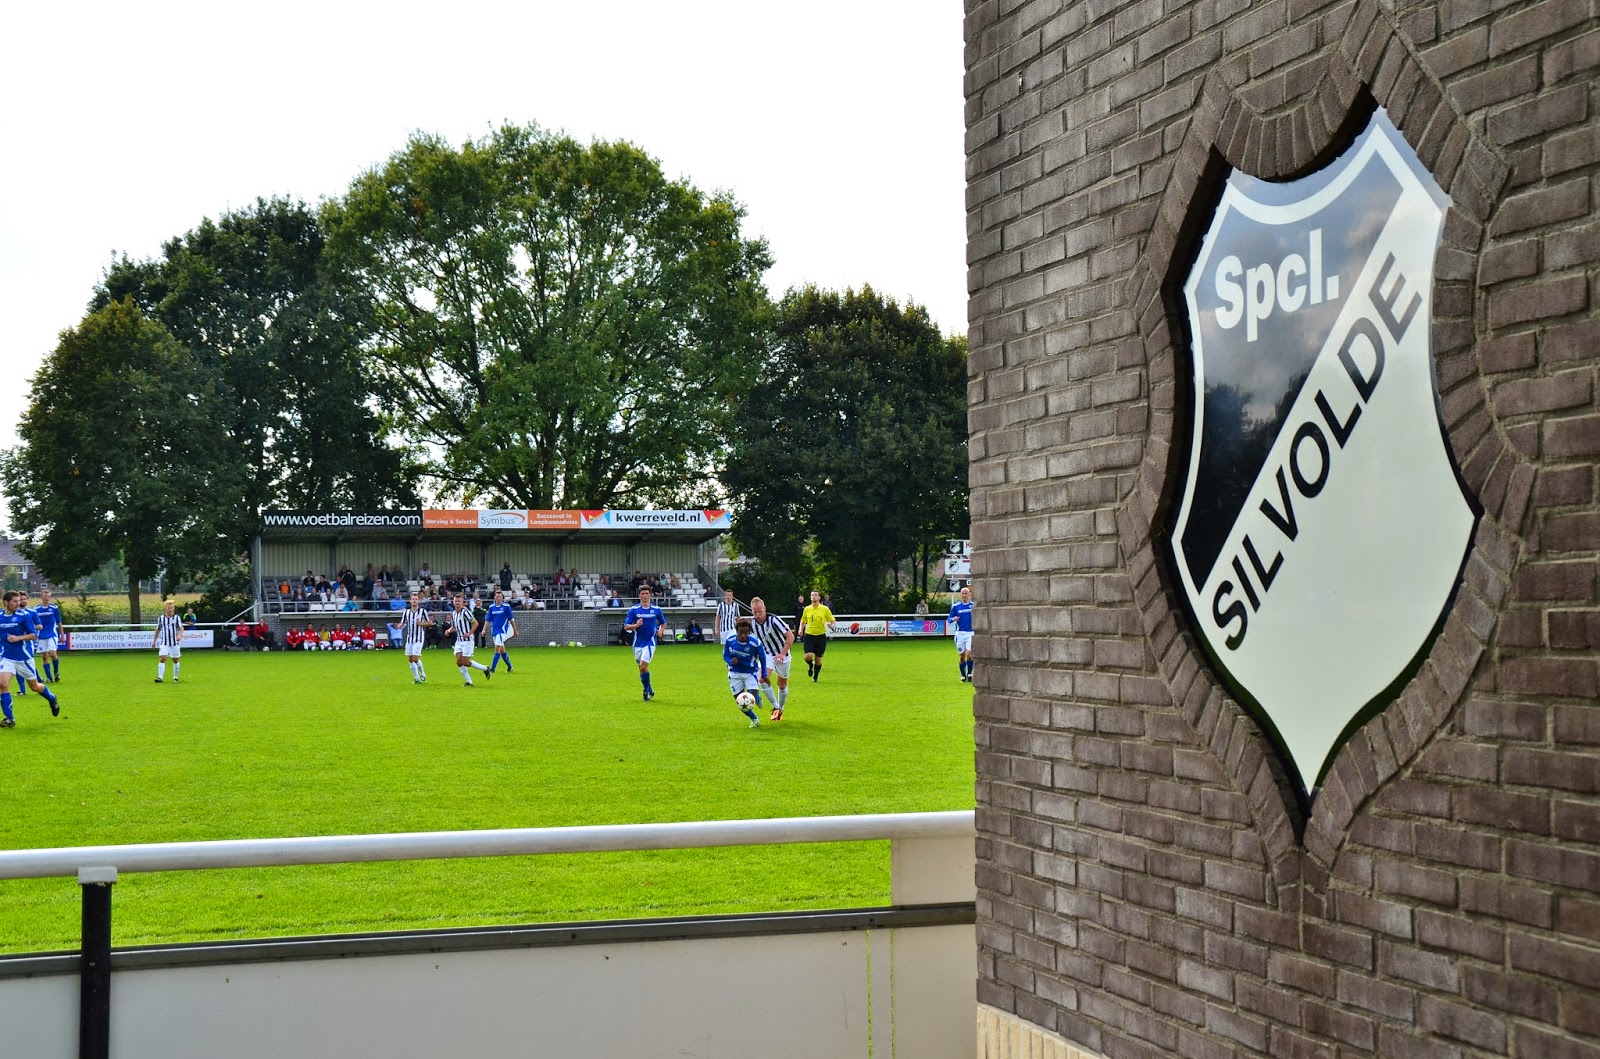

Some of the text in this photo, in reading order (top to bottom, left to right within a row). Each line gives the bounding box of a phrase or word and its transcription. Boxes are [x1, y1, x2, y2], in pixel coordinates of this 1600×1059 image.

[1214, 227, 1340, 342] Spcl.
[1212, 252, 1423, 651] SILVOLDE
[263, 512, 421, 526] www.voetbalreizen.com
[425, 518, 477, 527] Werving & Selectie
[481, 516, 516, 527] Symbus
[615, 512, 701, 522] kwerreveld.nl
[92, 633, 125, 641] Klomberg
